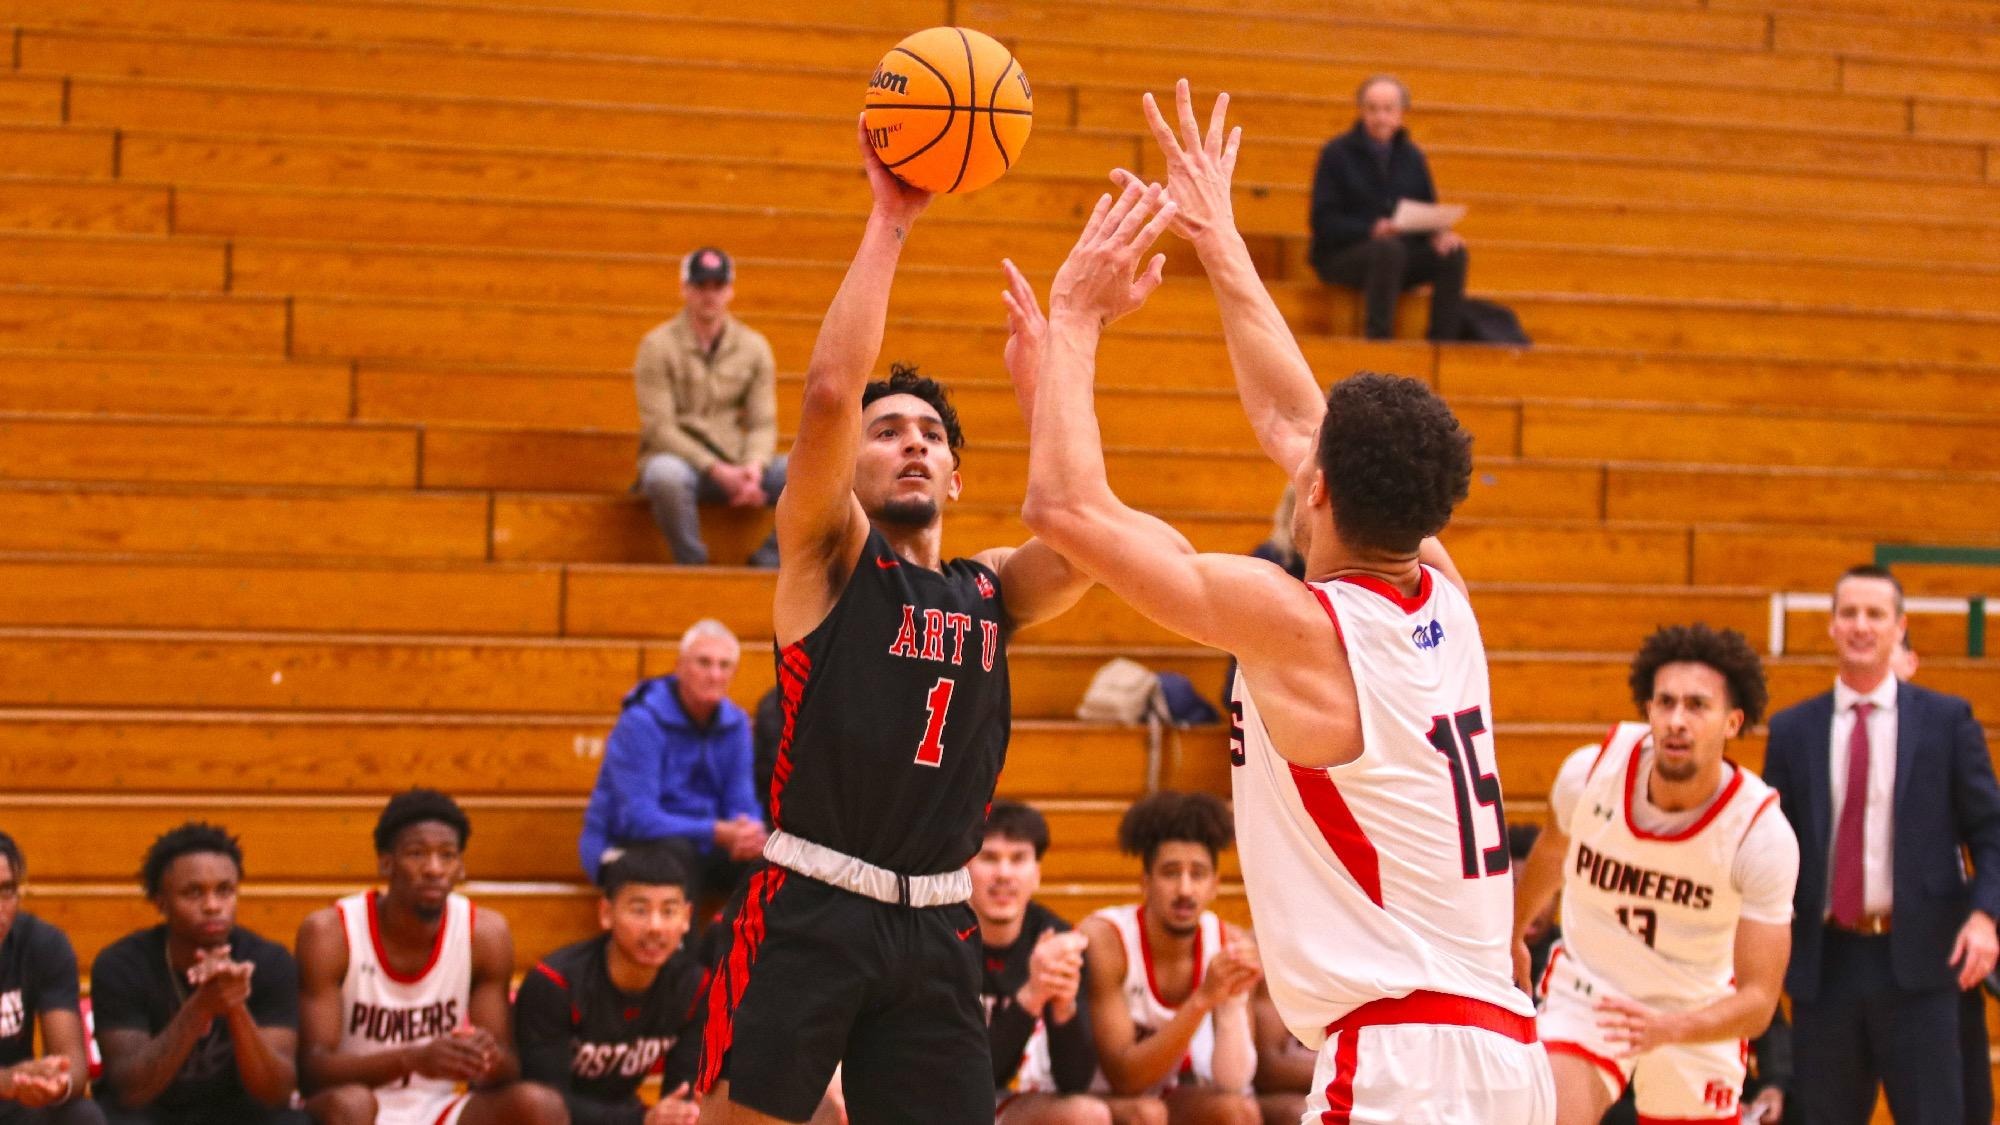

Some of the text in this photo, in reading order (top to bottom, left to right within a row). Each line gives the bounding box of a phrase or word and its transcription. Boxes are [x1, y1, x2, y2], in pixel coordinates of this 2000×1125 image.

[889, 604, 998, 673] ART U
[914, 677, 955, 767] 1
[1425, 705, 1510, 879] 15
[1576, 842, 1714, 909] PIONEERS
[350, 998, 457, 1042] PIONEERS
